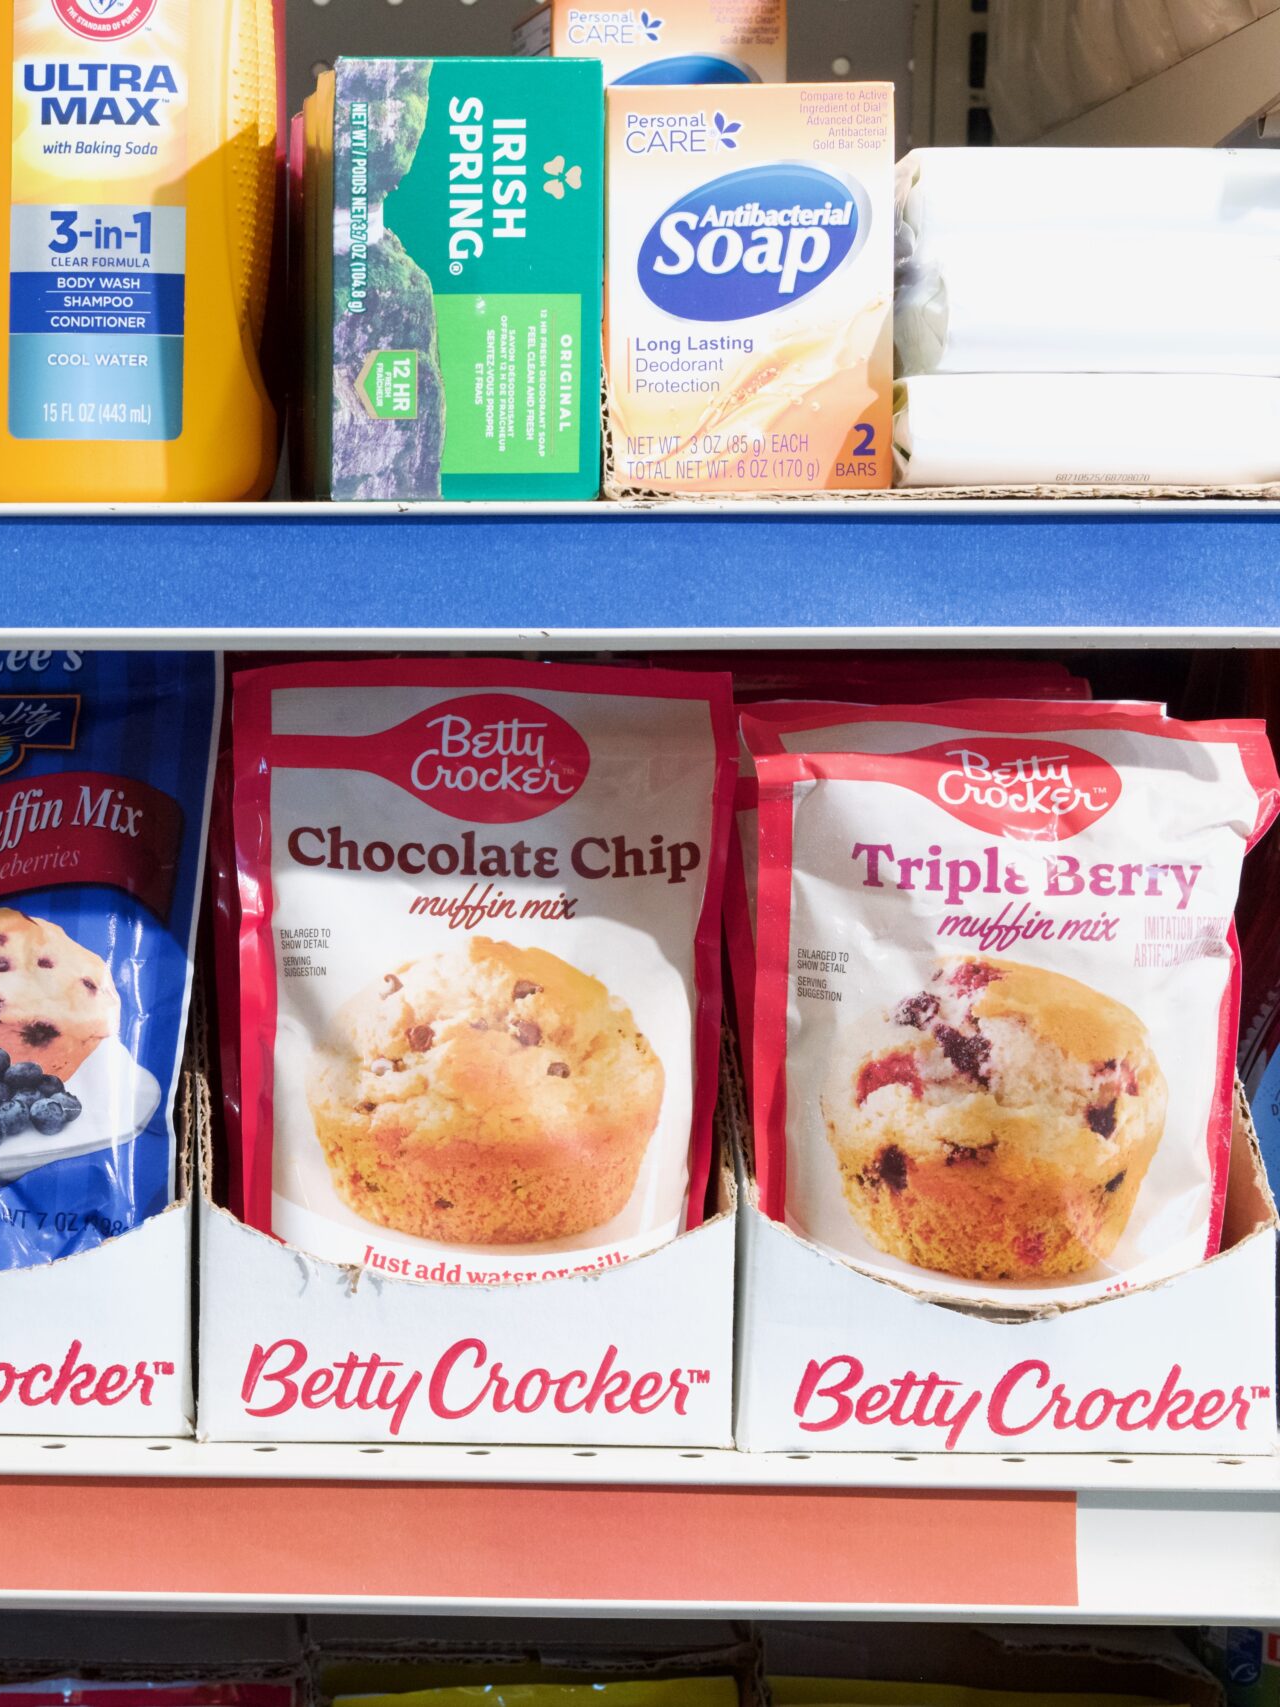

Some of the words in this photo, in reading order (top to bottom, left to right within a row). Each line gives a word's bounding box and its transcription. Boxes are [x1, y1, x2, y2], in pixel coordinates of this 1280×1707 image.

[569, 11, 634, 24] Personal
[567, 25, 635, 45] CARE
[24, 63, 178, 93] ULTRA
[351, 103, 367, 126] NET
[627, 113, 707, 129] Personal
[43, 141, 71, 154] with
[75, 141, 121, 157] Baking
[125, 142, 158, 155] Soda
[351, 129, 367, 148] WT
[626, 130, 707, 154] CARE
[351, 158, 367, 195] POIDS
[492, 118, 527, 238] IRISH
[351, 197, 367, 221] NET
[700, 200, 854, 228] Antibacterial
[48, 210, 152, 254] 3-in-1
[351, 222, 367, 242] 3.7
[51, 256, 88, 267] CLEAR
[92, 256, 150, 268] FORMULA
[351, 243, 367, 259] OZ
[653, 211, 831, 294] Soap
[57, 277, 96, 288] BODY
[99, 277, 140, 289] WASH
[350, 262, 367, 298] (104.8
[63, 296, 133, 308] SHAMPOO
[348, 300, 366, 313] g)
[50, 316, 145, 328] CONDITIONER
[526, 325, 536, 350] FEEL
[635, 338, 681, 355] Long
[687, 336, 754, 354] Lasting
[47, 353, 90, 366] COOL
[94, 354, 148, 367] WATER
[392, 358, 411, 379] 12
[526, 352, 536, 384] CLEAN
[635, 357, 724, 372] Deodorant
[559, 334, 573, 432] ORIGINAL
[635, 378, 720, 393] Protection
[392, 383, 410, 411] HR
[525, 385, 535, 407] AND
[525, 409, 535, 440] FRESH
[851, 423, 876, 457] 2
[835, 463, 877, 477] BARS
[426, 714, 548, 768] Betty
[410, 748, 574, 796] Crocker
[945, 749, 1072, 788] Betty
[70, 785, 143, 838] Mix
[287, 825, 559, 879] Chocolate
[571, 834, 702, 884] Chip
[851, 843, 1030, 905] Triple
[1044, 855, 1203, 911] Berry
[409, 882, 518, 930] muffin
[520, 893, 579, 920] mix
[280, 928, 319, 939] ENLARGED
[321, 928, 331, 938] TO
[937, 901, 1055, 951] muffin
[1057, 912, 1120, 943] mix
[797, 960, 818, 971] SHOW
[819, 961, 847, 973] DETAIL
[241, 1338, 422, 1436] Betty
[793, 1355, 982, 1451] Betty
